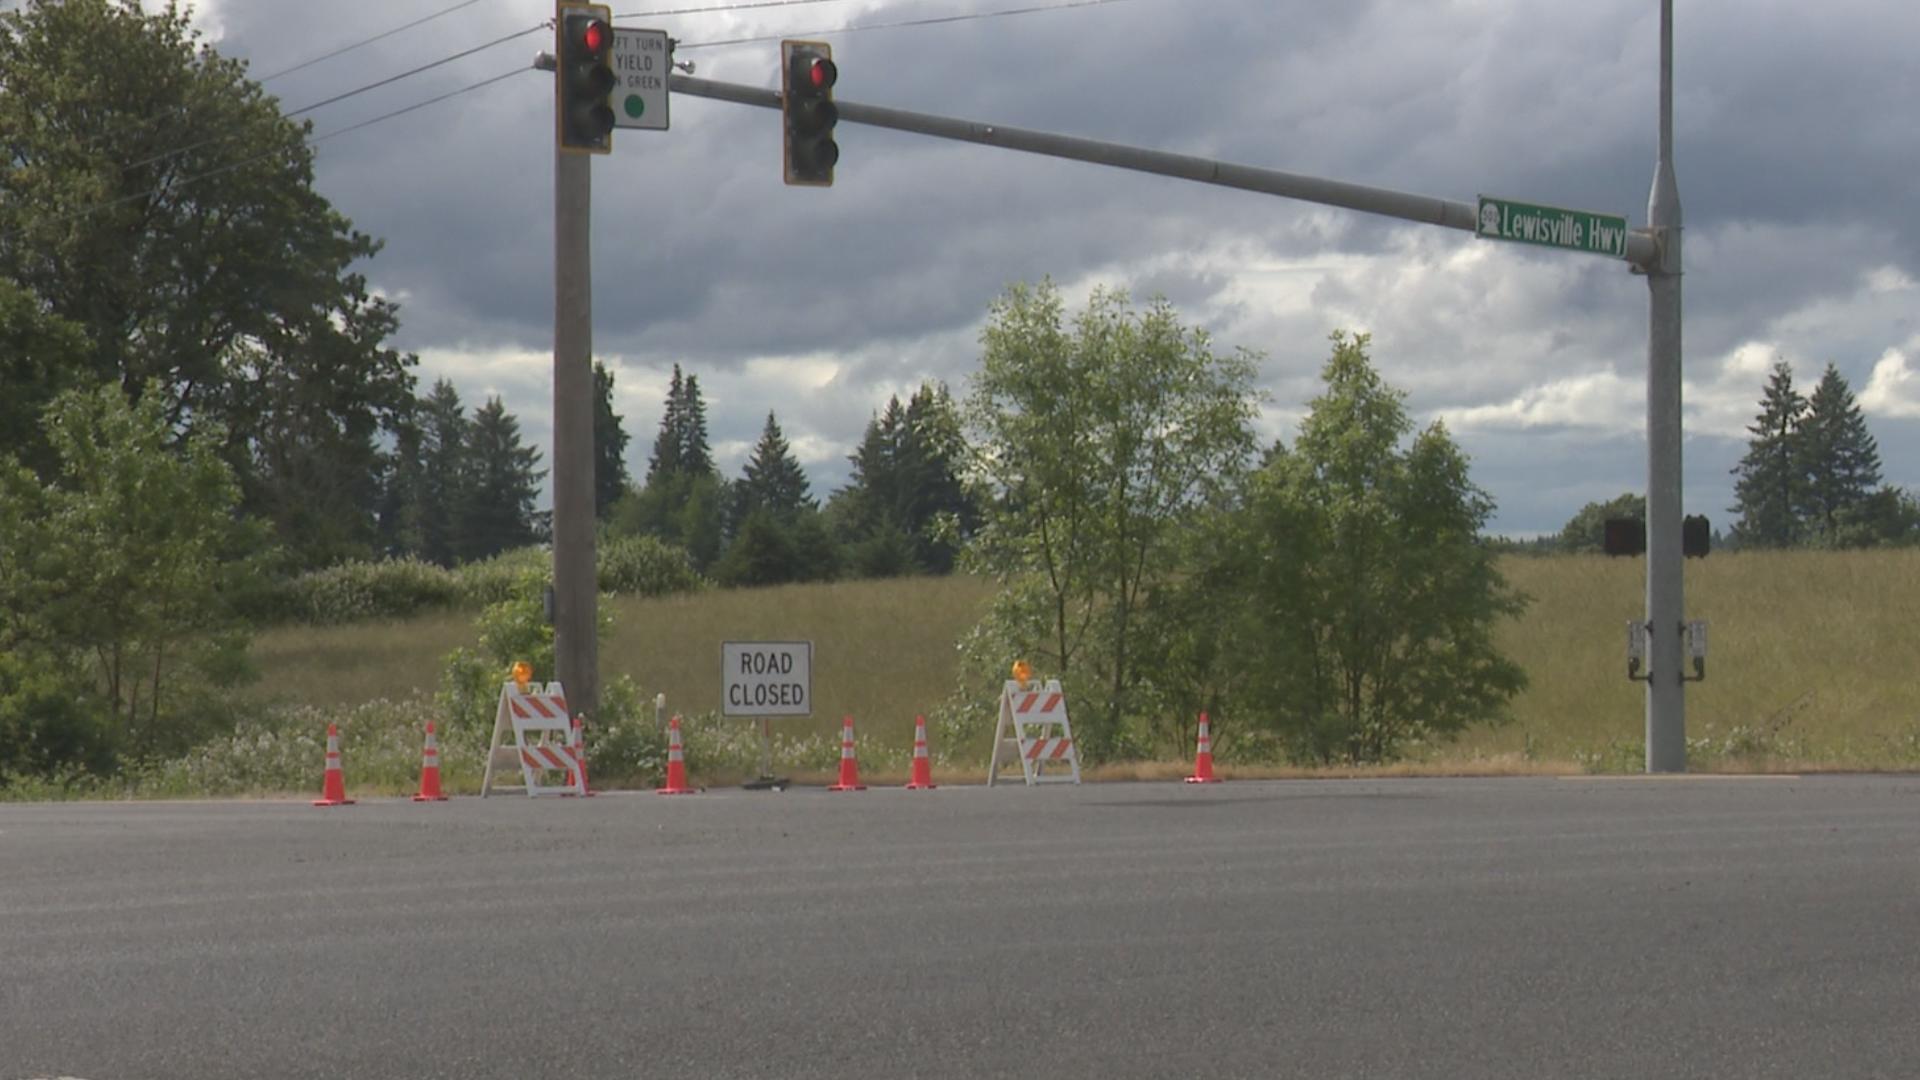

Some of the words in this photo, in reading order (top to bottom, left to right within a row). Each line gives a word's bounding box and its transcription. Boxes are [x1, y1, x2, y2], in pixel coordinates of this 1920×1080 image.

[635, 36, 663, 51] TURN
[615, 53, 653, 71] YIELD
[627, 74, 662, 89] GREEN
[1503, 204, 1583, 246] Lewisville
[1588, 217, 1624, 255] Hwy
[741, 651, 793, 675] ROAD
[729, 682, 804, 707] CLOSED
